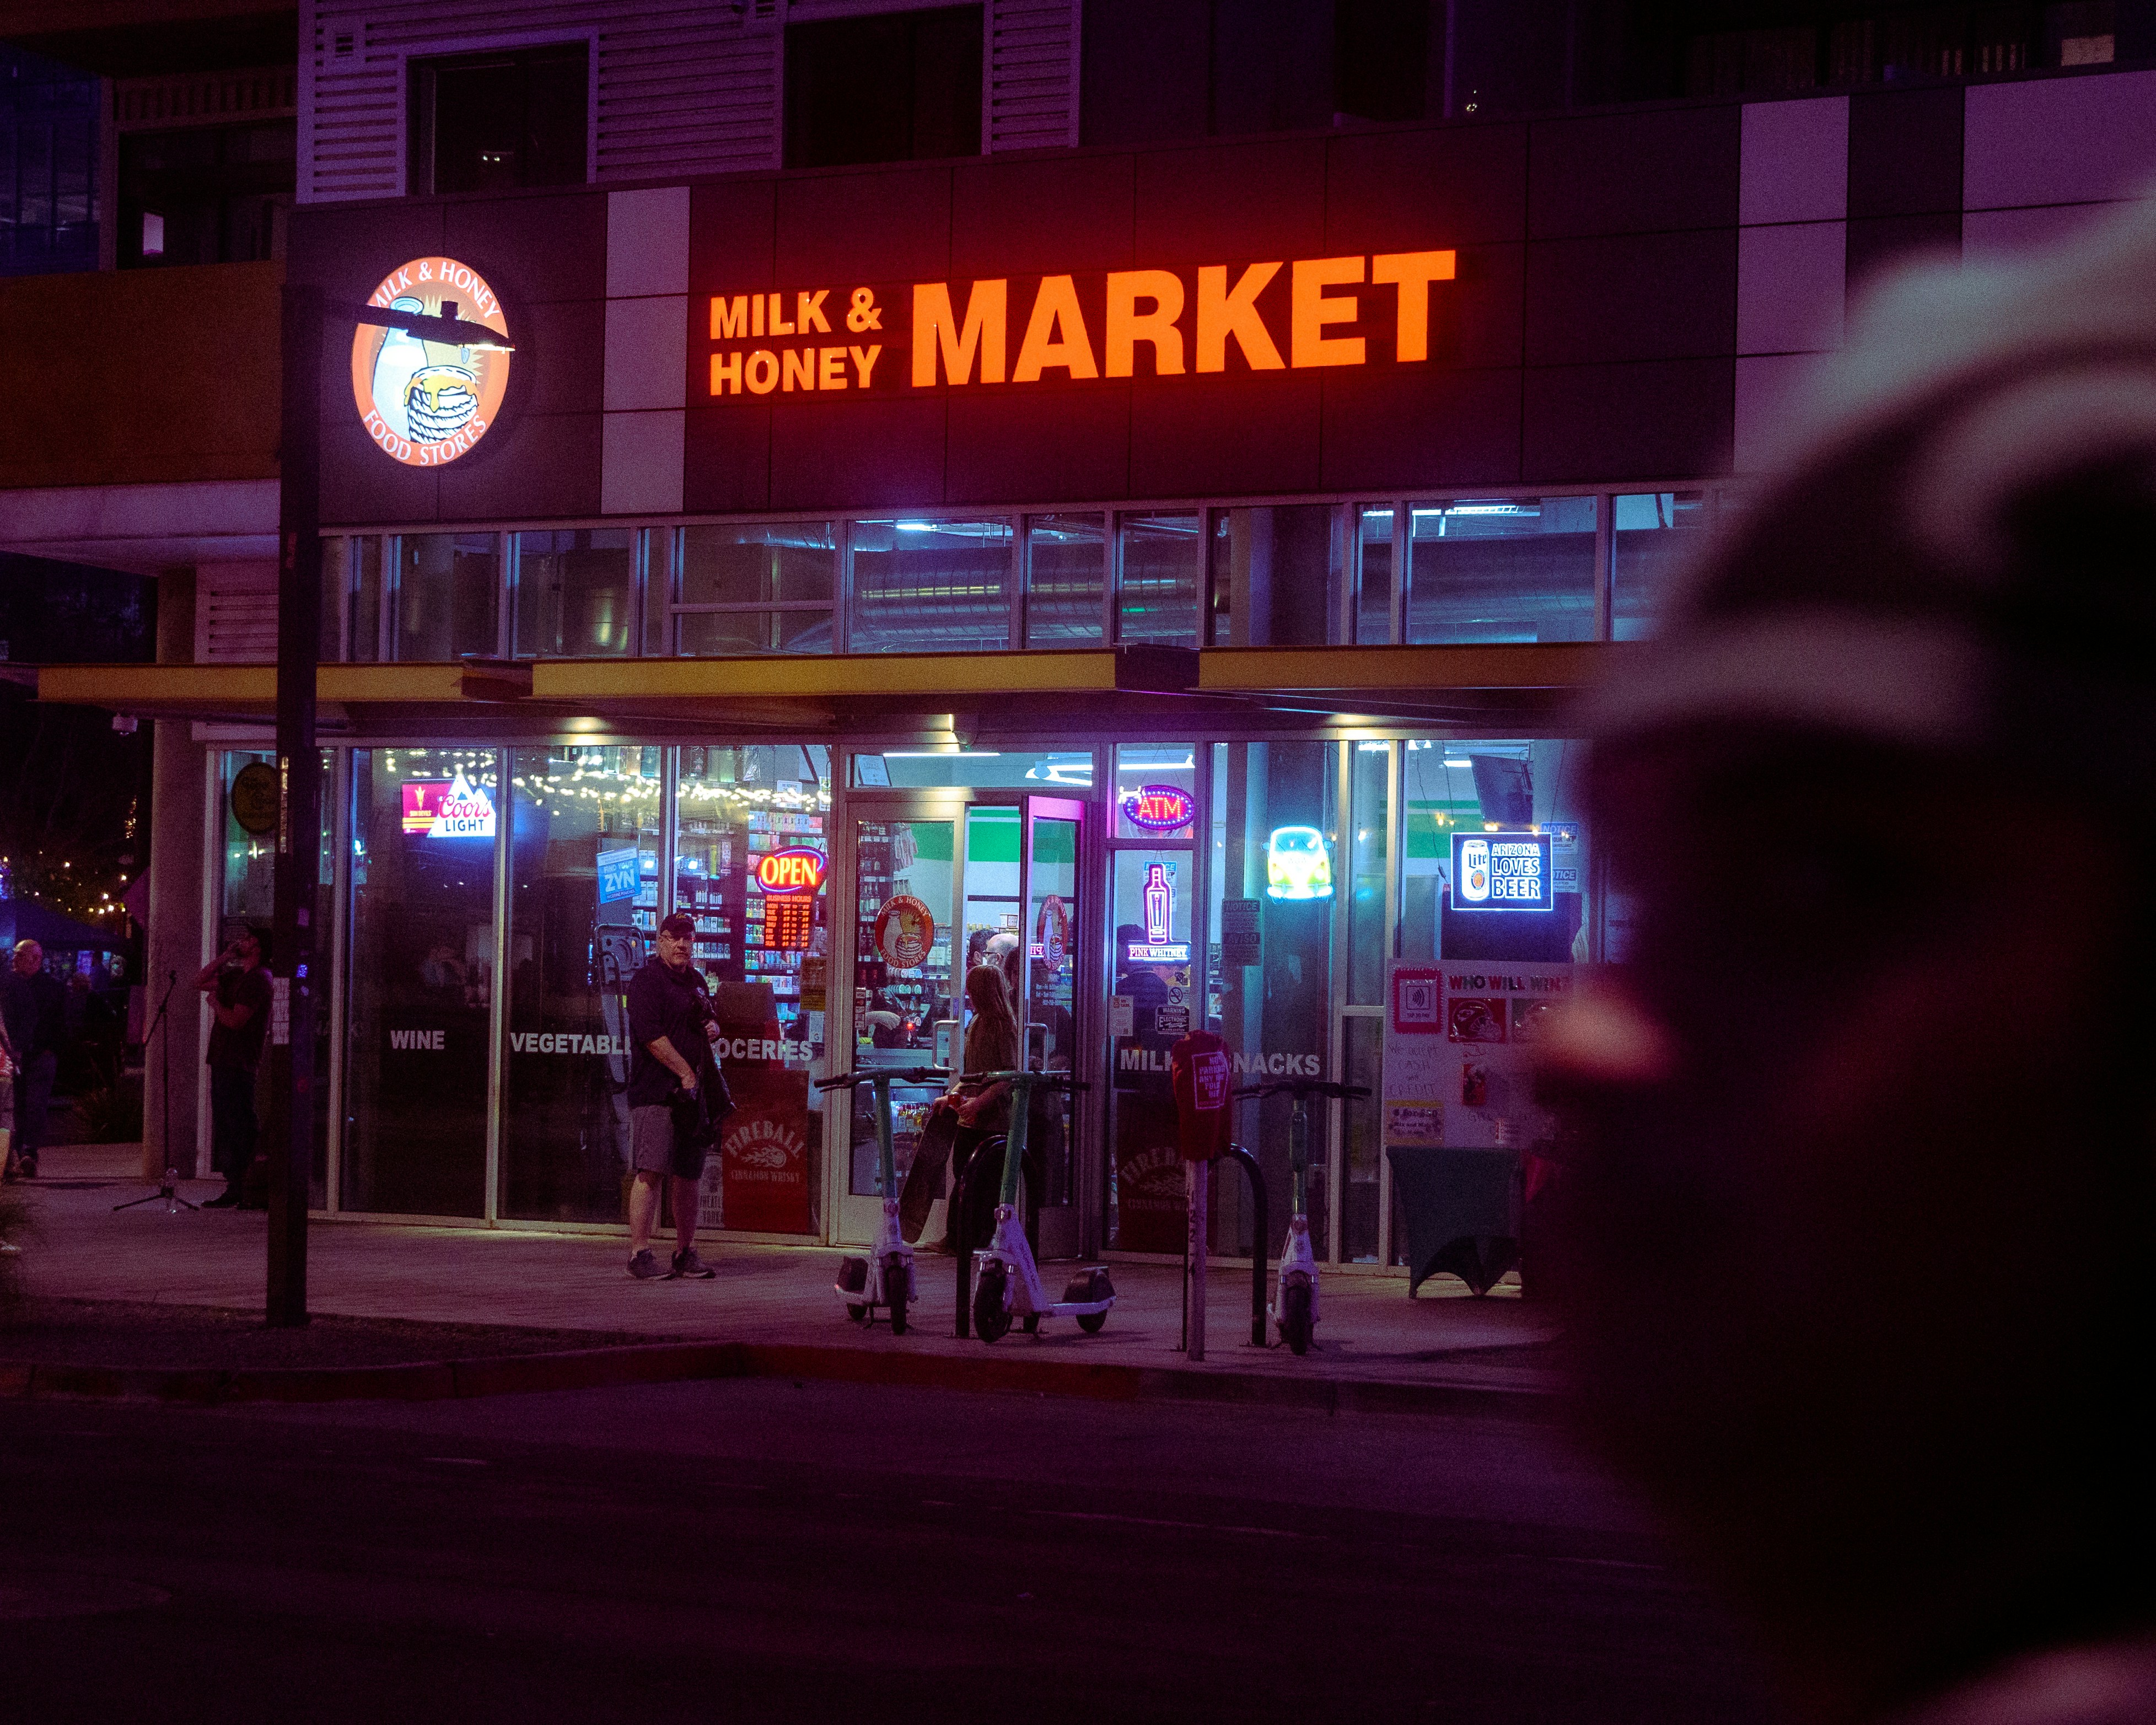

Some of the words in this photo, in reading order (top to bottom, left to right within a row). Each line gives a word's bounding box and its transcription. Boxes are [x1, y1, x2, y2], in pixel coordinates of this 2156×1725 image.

[419, 262, 432, 281] &
[440, 261, 500, 319] HONEY
[710, 289, 832, 340] MILK
[846, 287, 883, 334] &
[912, 249, 1456, 388] MARKET
[710, 345, 882, 396] HONEY
[363, 409, 411, 460] FOOD
[420, 415, 486, 466] STORES
[438, 794, 491, 819] Coors
[1138, 796, 1181, 820] ATM
[445, 819, 484, 831] LIGHT
[1543, 825, 1577, 834] NOTICE
[1492, 843, 1540, 856] ARIZONA
[761, 856, 817, 885] OPEN
[1469, 853, 1487, 869] Lite
[1492, 858, 1540, 875] LOVES
[604, 868, 635, 892] ZYN
[1492, 877, 1541, 899] BEER
[881, 900, 896, 916] MILK
[906, 897, 929, 916] HONEY
[1225, 902, 1257, 911] NOTICE
[880, 949, 899, 966] FOOD
[902, 950, 926, 968] STORES
[1129, 948, 1149, 957] PINK
[1149, 948, 1187, 957] WHITNEY
[1449, 976, 1486, 990] WHO
[1489, 976, 1525, 991] WILL
[1159, 1016, 1187, 1028] ELECTRONIC
[391, 1030, 445, 1050] WINE
[711, 1038, 813, 1061] OCERIES
[1229, 1052, 1320, 1075] NACKS
[725, 1120, 805, 1159] FIREBALL
[730, 1169, 769, 1181] CINNAMON
[770, 1171, 800, 1183] WHISKY
